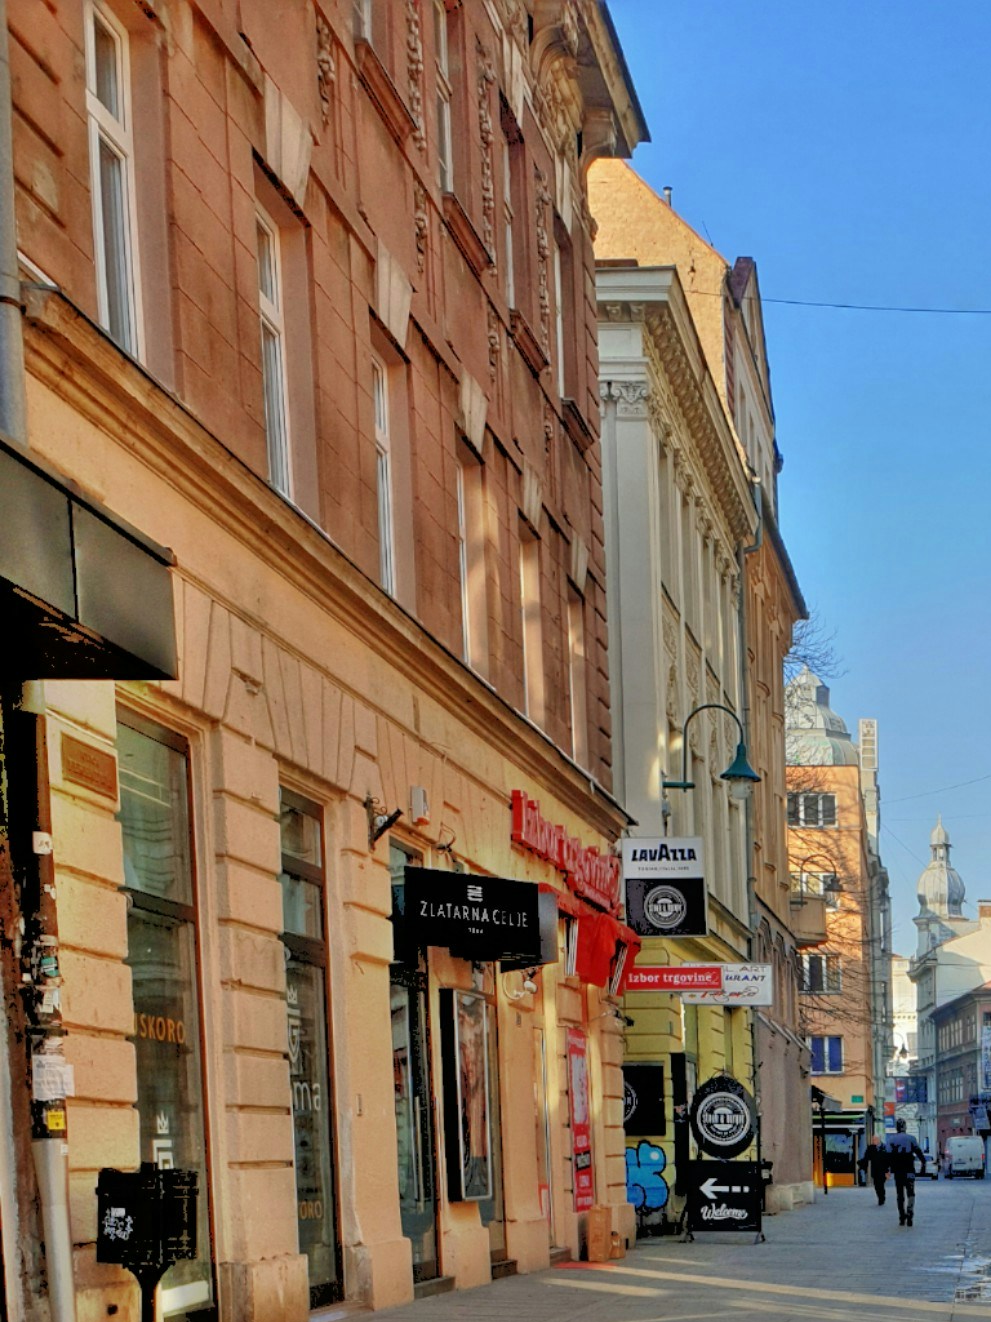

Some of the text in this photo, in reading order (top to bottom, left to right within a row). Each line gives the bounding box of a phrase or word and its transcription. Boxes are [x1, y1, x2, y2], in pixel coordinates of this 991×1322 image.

[631, 843, 697, 862] LAVAZZA
[420, 900, 490, 923] ZLATARNA
[662, 971, 713, 986] trgovine
[134, 1013, 186, 1044] SKORO
